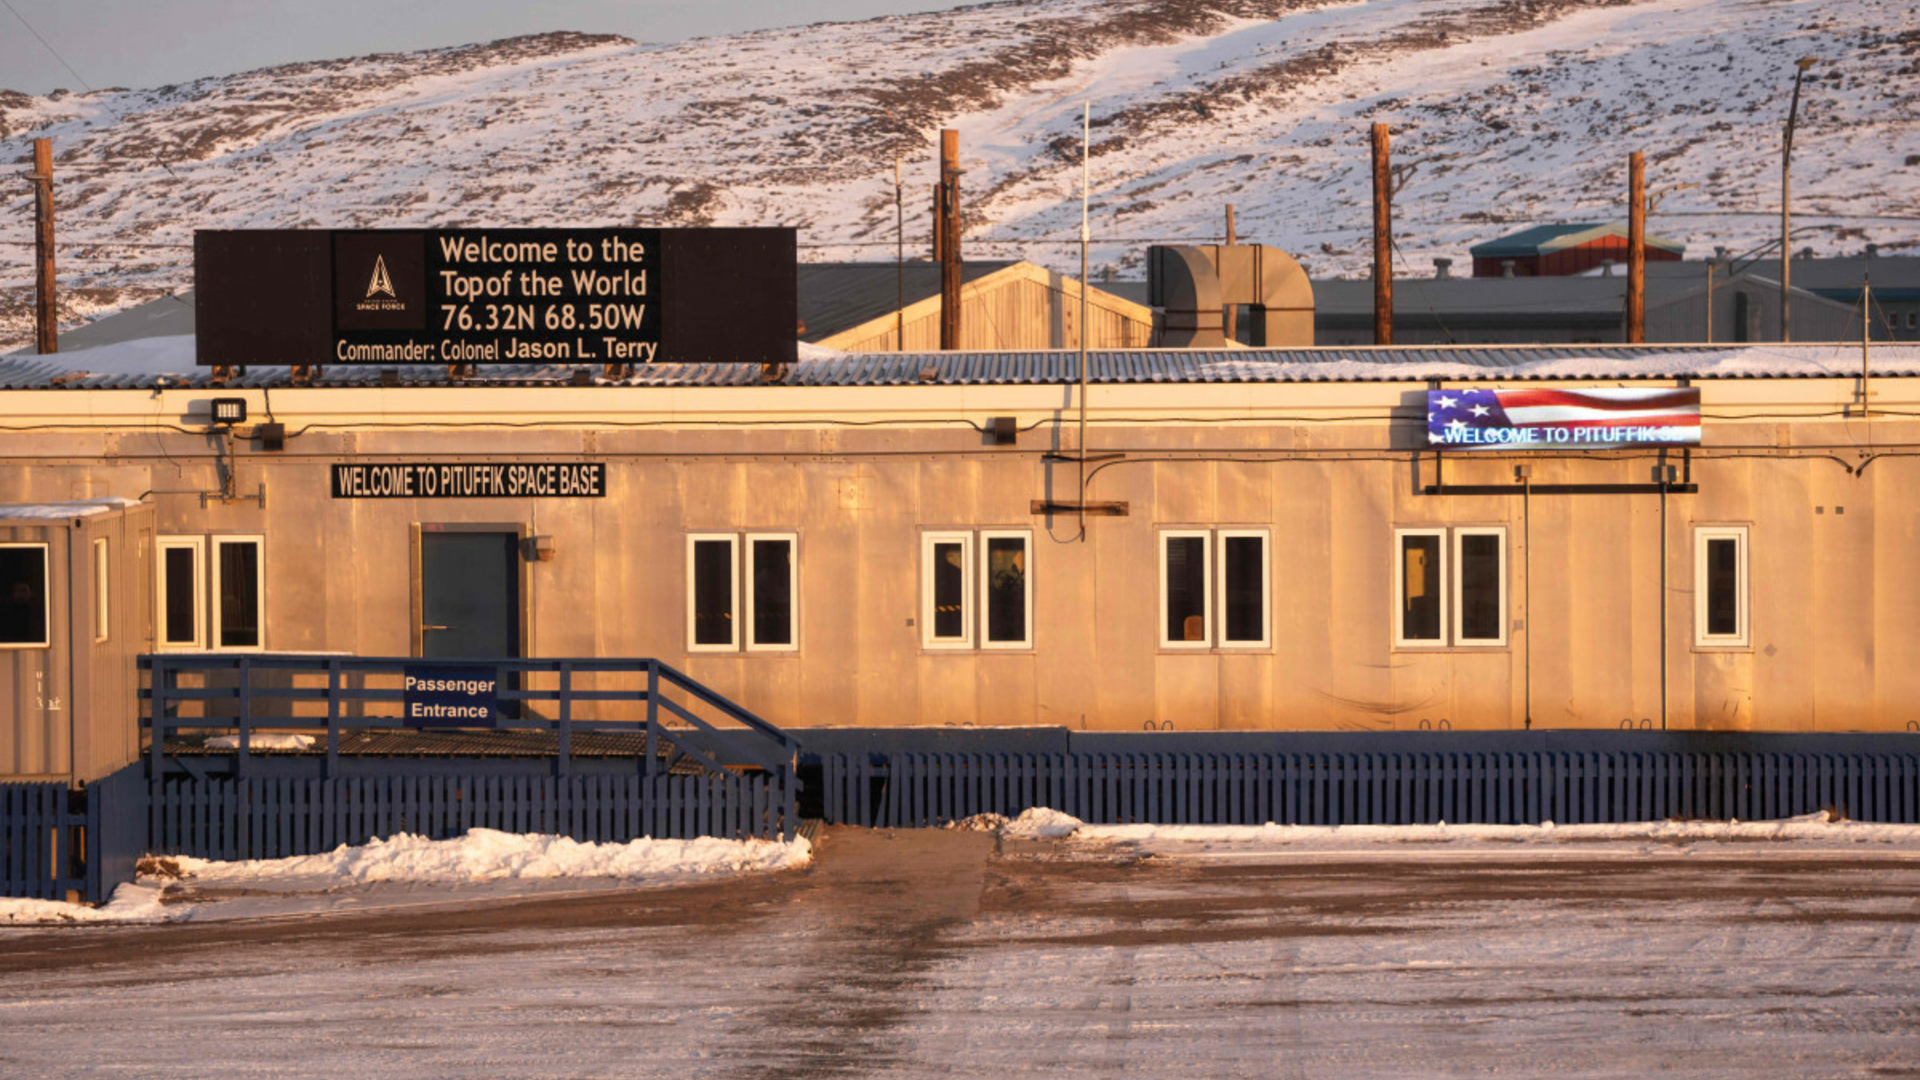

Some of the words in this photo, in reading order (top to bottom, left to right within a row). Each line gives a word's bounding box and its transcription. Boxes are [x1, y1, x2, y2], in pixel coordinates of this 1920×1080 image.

[439, 236, 558, 263] Welcome
[566, 238, 593, 263] to
[601, 236, 645, 263] the
[520, 270, 563, 296] the
[571, 269, 647, 296] World
[441, 304, 535, 331] 76.32N
[545, 304, 645, 330] 68.50W
[337, 339, 435, 361] Commander:
[441, 338, 499, 360] Colonel
[505, 337, 570, 358] Jason
[577, 337, 596, 358] L.
[603, 337, 657, 362] Terry
[1444, 427, 1539, 443] WELCOME
[1542, 427, 1569, 442] TO
[1573, 426, 1655, 442] PITUFFIK
[339, 466, 413, 496] WELCOME
[417, 466, 437, 495] TO
[441, 465, 505, 495] PITUFFIK
[508, 465, 556, 495] SPACE
[560, 465, 599, 494] BASE
[405, 676, 495, 695] Passenger
[412, 702, 488, 718] Entrance
